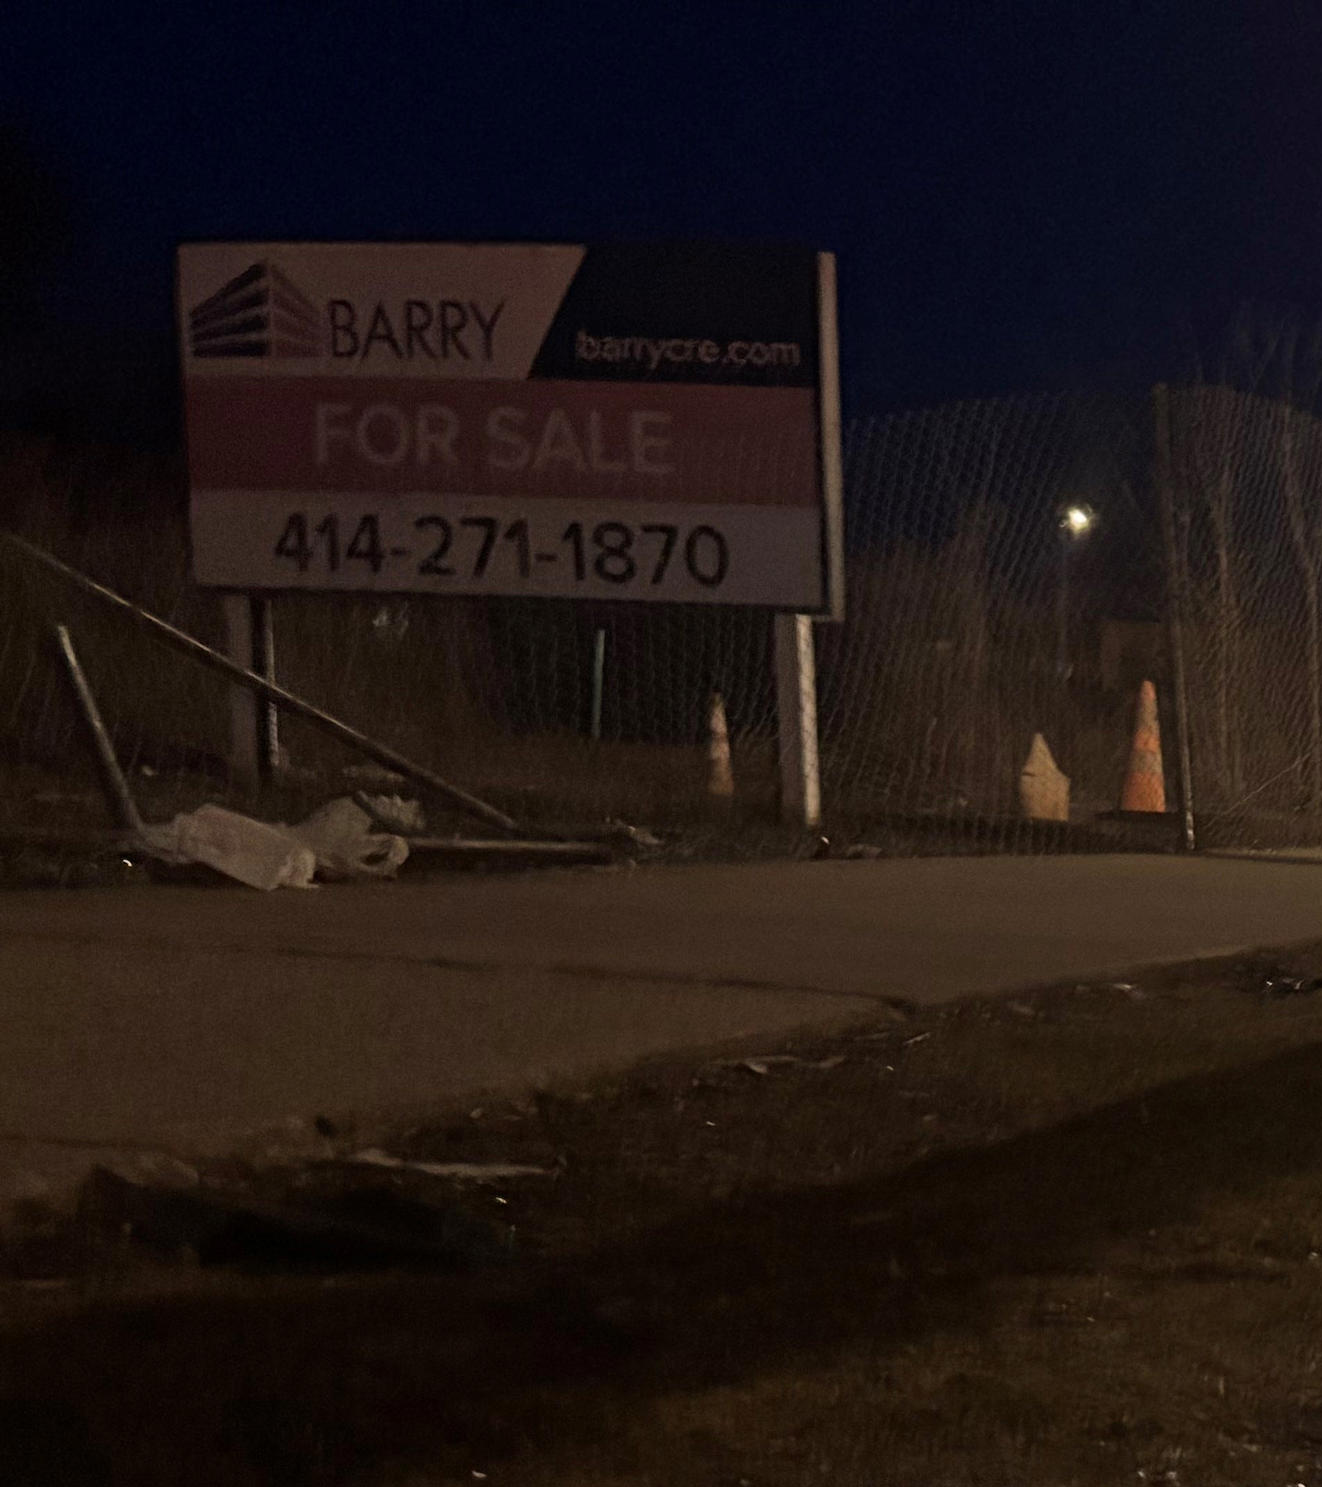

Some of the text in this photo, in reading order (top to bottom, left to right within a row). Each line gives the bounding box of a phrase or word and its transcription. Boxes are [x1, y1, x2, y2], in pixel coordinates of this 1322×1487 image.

[327, 299, 505, 360] BARRY
[576, 328, 801, 370] barrycre.com
[314, 401, 678, 474] FOR SALE
[274, 513, 730, 588] 414-271-1870
